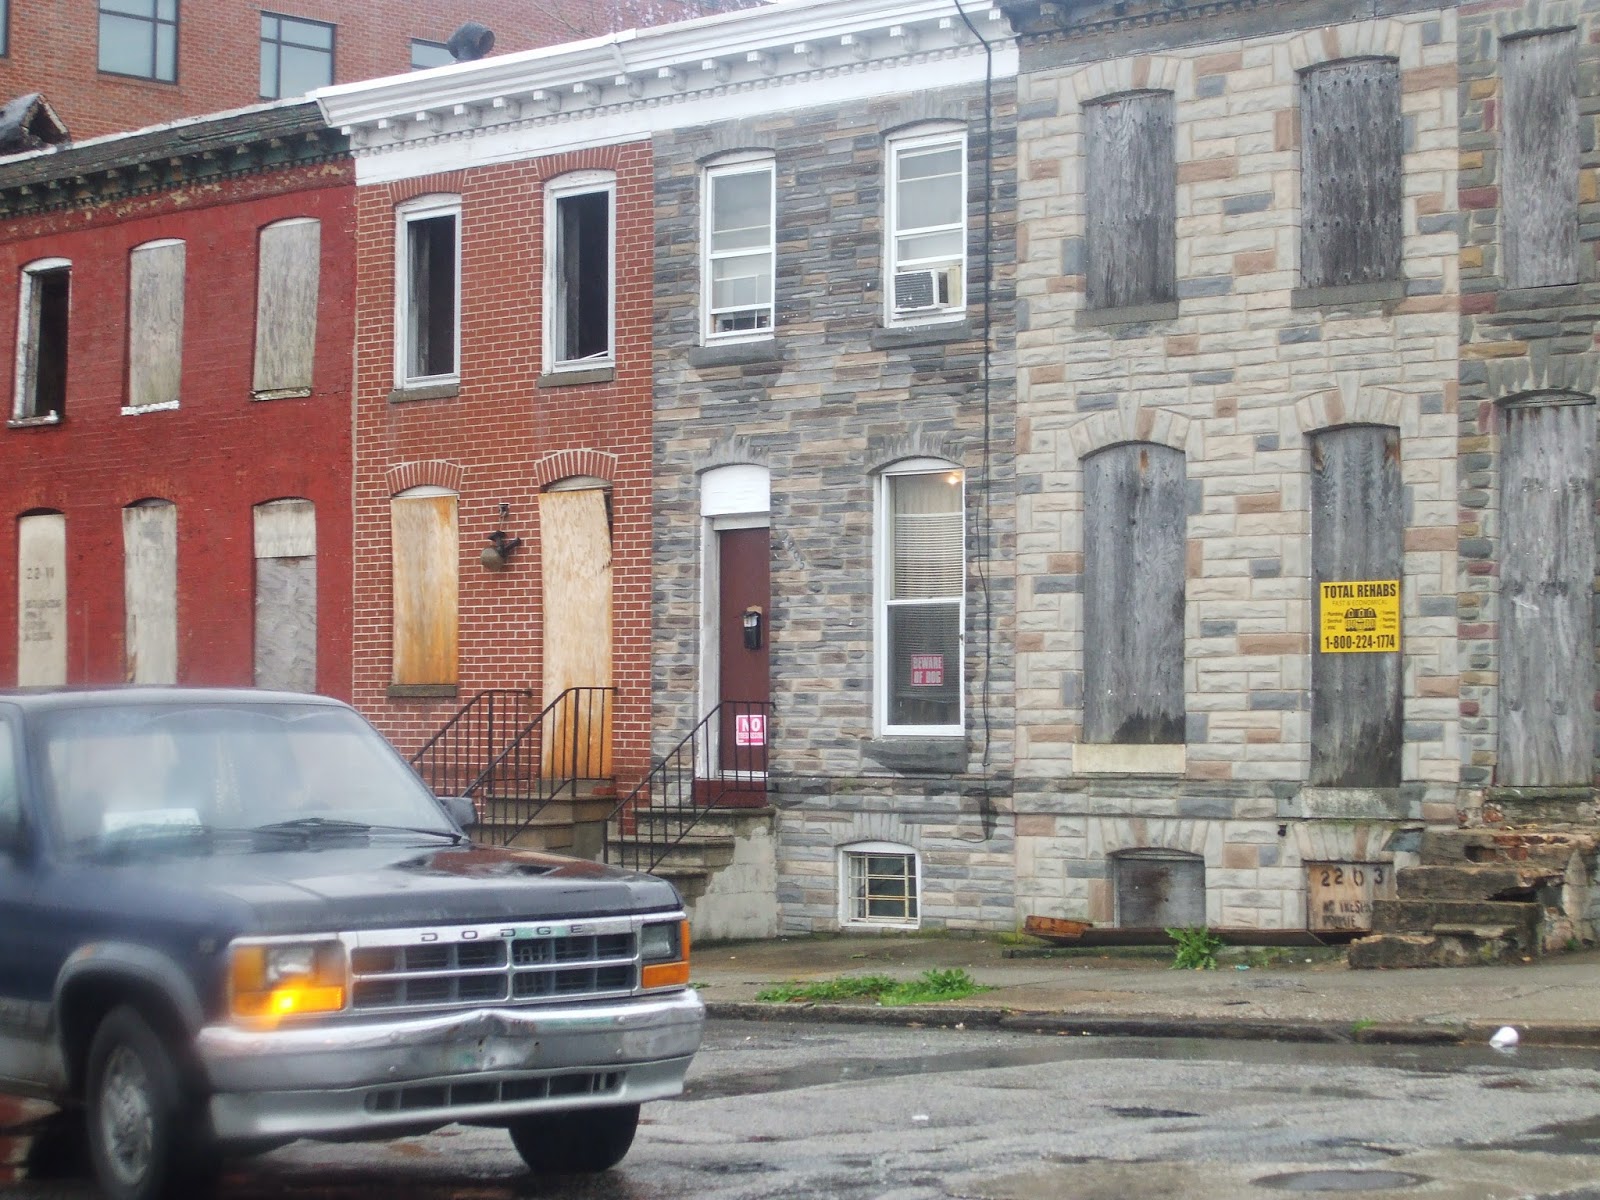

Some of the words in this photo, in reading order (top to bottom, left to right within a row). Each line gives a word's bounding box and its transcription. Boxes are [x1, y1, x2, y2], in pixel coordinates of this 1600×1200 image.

[1324, 585, 1354, 599] TOTAL
[1357, 583, 1396, 598] REHABS
[1325, 634, 1395, 649] 1-800-224-1774
[913, 656, 942, 669] BEWARE
[913, 671, 923, 683] OF
[926, 671, 941, 683] DOG
[742, 718, 761, 731] NO
[420, 923, 585, 942] DODGE
